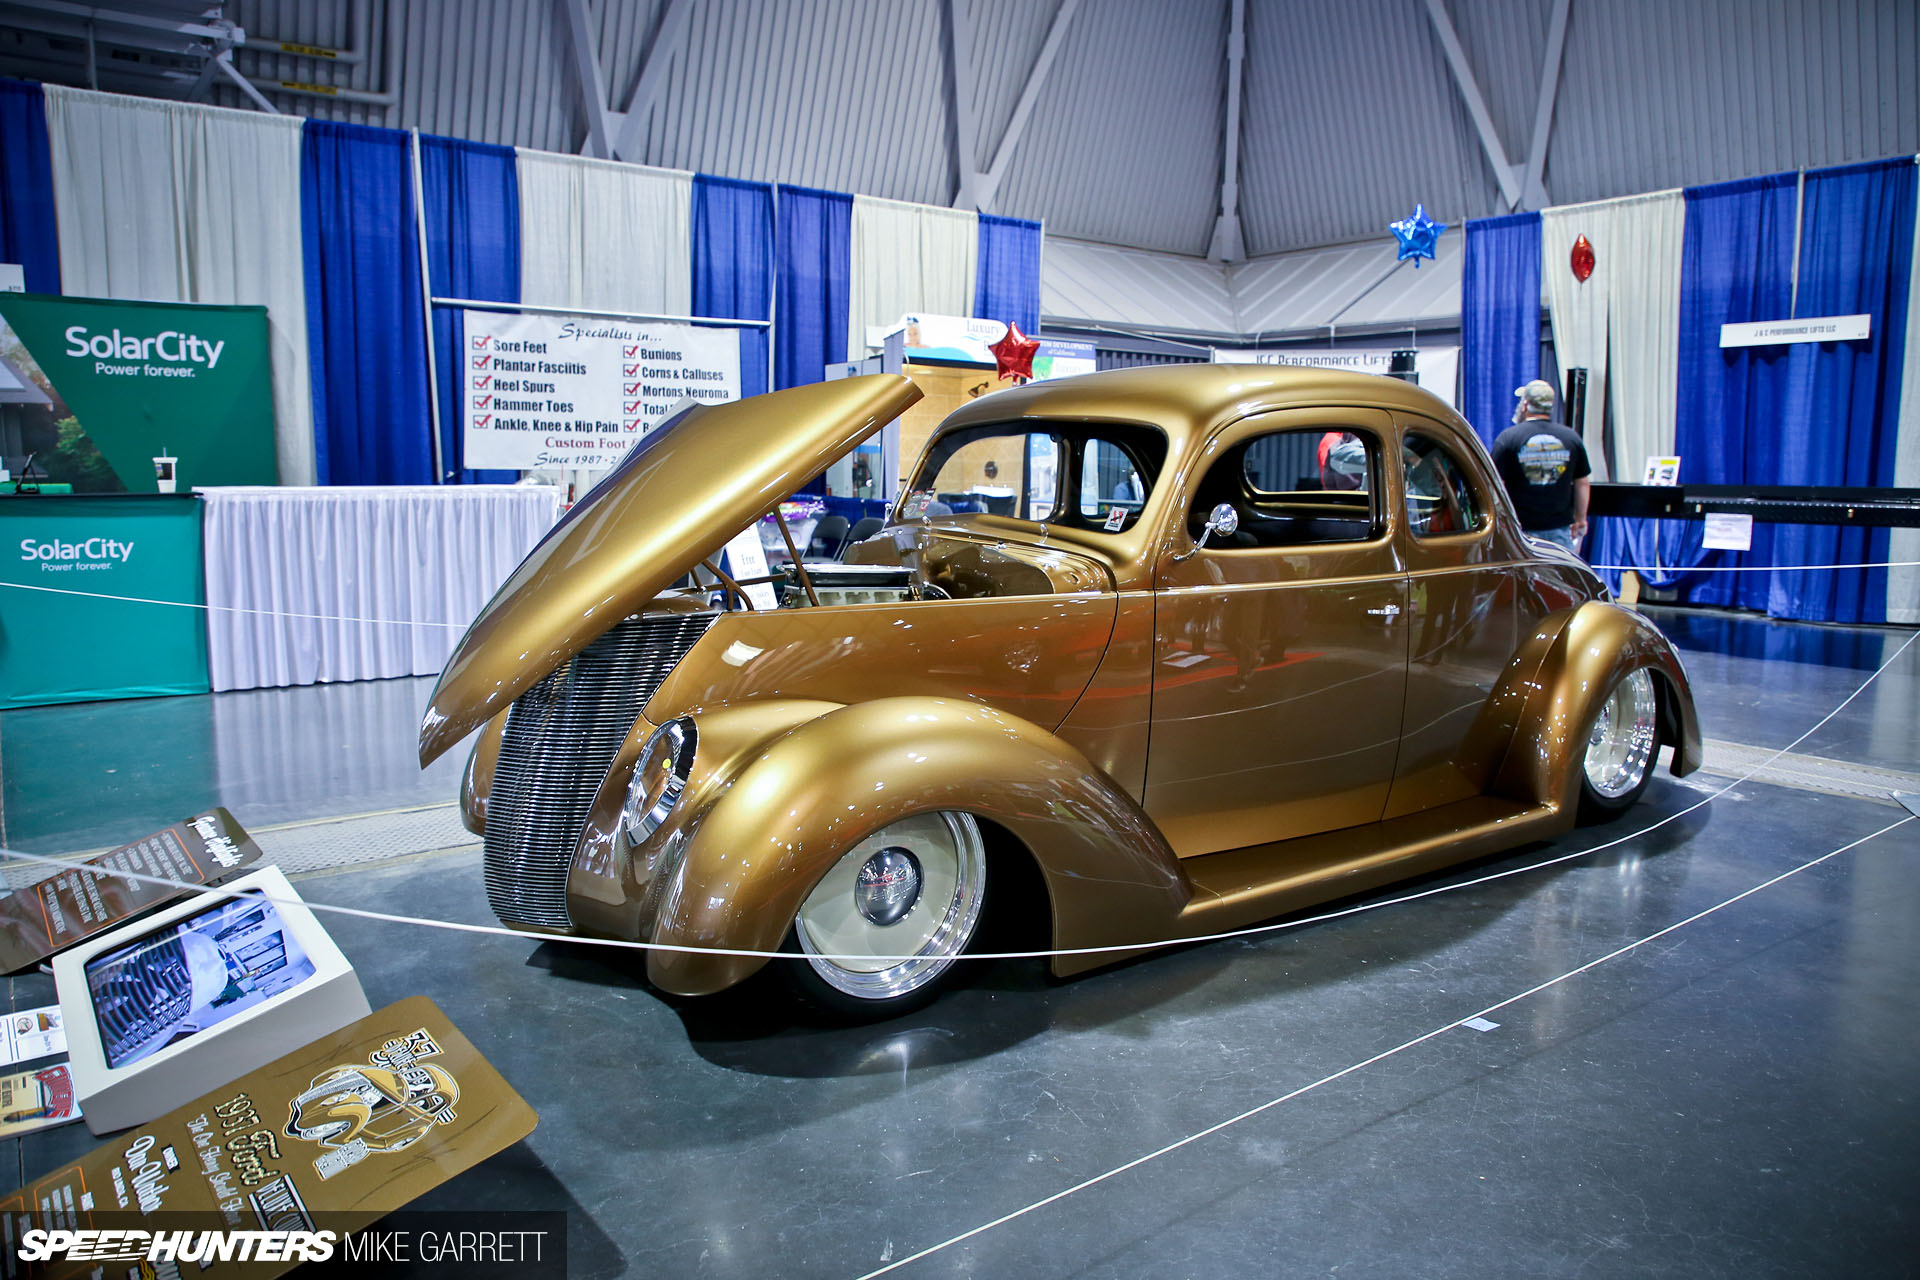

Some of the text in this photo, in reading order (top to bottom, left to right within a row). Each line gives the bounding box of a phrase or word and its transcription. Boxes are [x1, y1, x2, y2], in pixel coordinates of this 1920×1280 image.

[65, 326, 225, 369] SolarCity
[493, 340, 547, 354] Sore Feet
[640, 348, 683, 361] Bunions
[493, 358, 587, 375] Plantar Fasciitis
[1278, 355, 1359, 367] PERFORMANCE
[1363, 354, 1393, 366] LIFTS
[95, 362, 196, 378] Power forever.
[642, 366, 724, 381] Corns & Calluses
[493, 379, 555, 394] Heel Spurs
[642, 385, 729, 399] Mortons Neuroma
[493, 398, 574, 413] Hammer Toes
[643, 403, 668, 415] Total
[494, 418, 619, 433] Ankle, Knee & Hip Pain
[545, 436, 595, 448] Custom
[599, 437, 626, 449] Foot
[533, 452, 569, 466] Since
[575, 455, 602, 464] 1987
[20, 537, 134, 562] SolarCity
[41, 561, 113, 572] Power forever.
[214, 1092, 260, 1136] 1937
[124, 1135, 155, 1171] Dan
[200, 1145, 222, 1175] Henry
[226, 1129, 282, 1186] Ford
[256, 1177, 295, 1220] DELUXE
